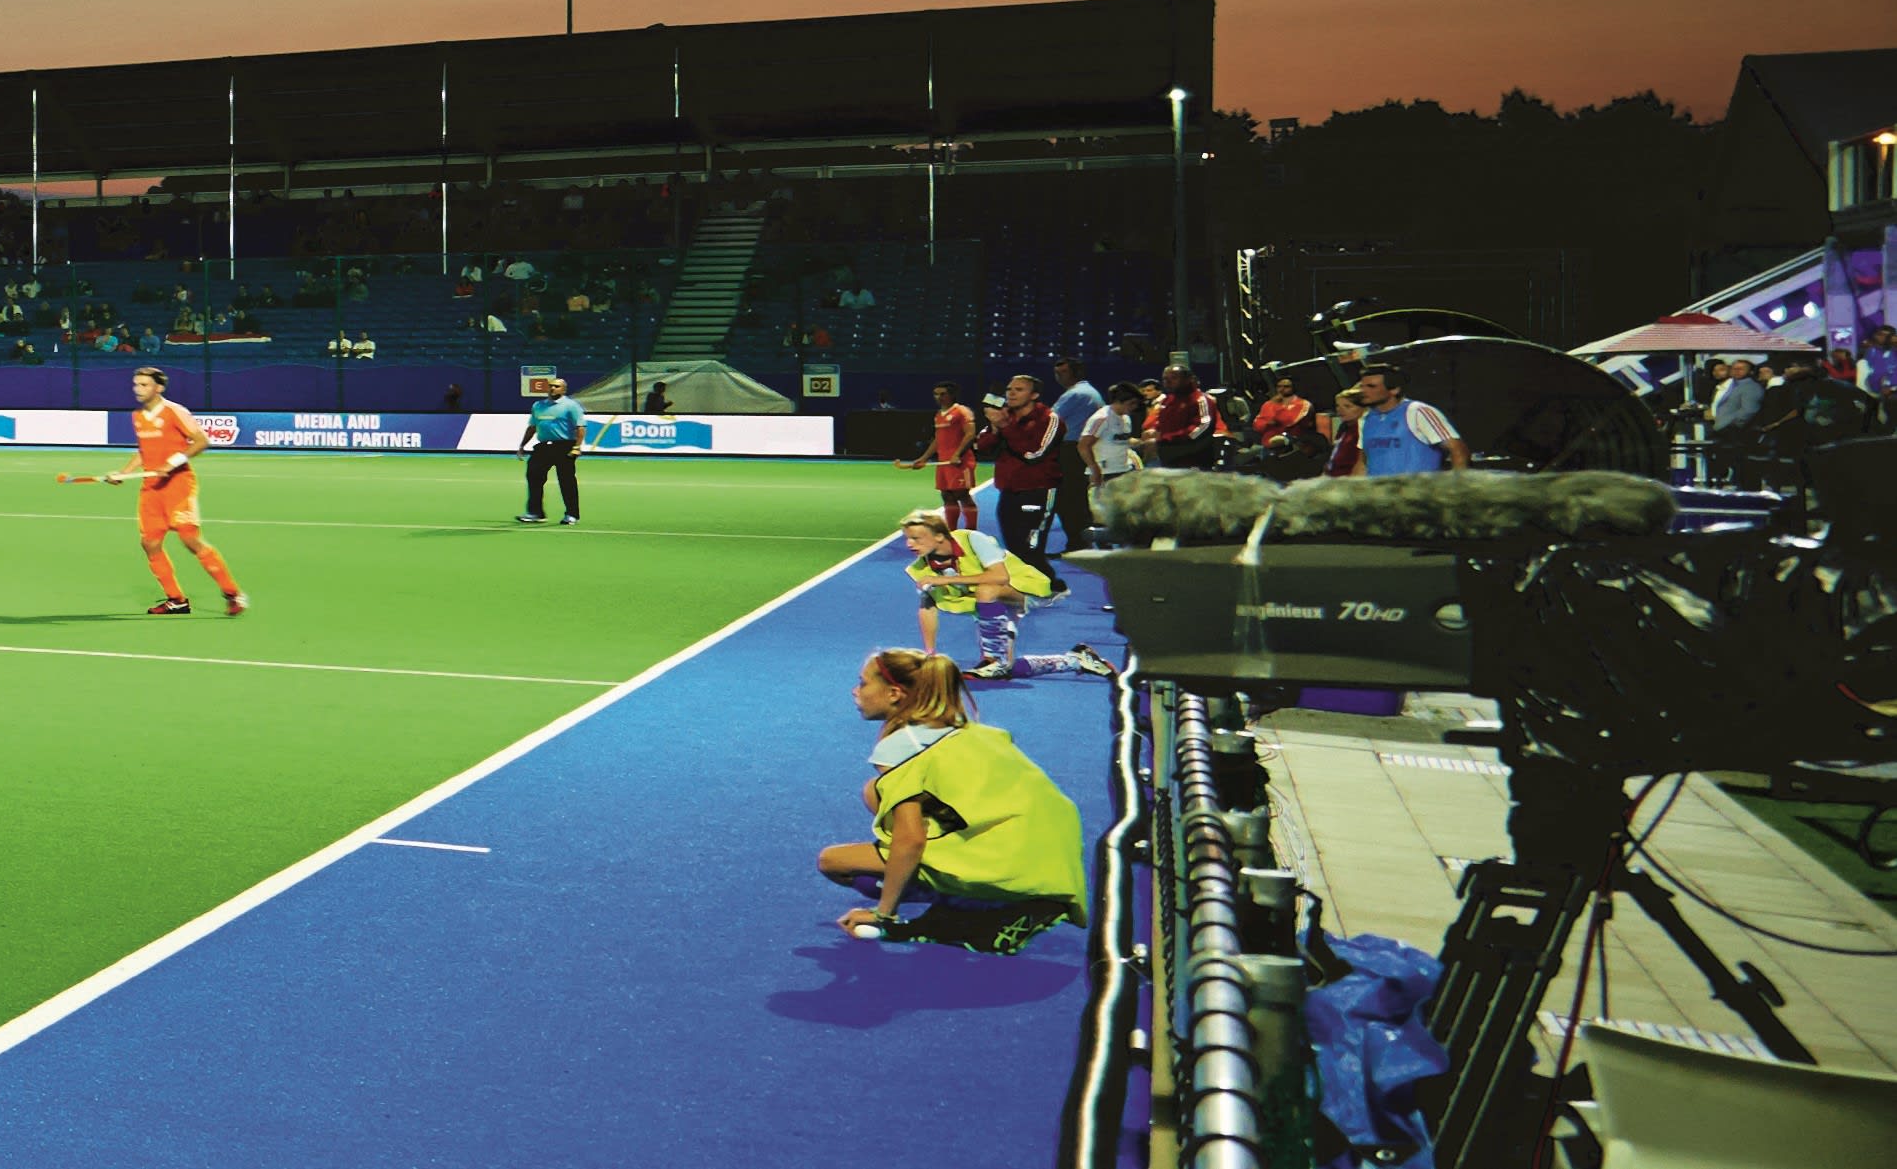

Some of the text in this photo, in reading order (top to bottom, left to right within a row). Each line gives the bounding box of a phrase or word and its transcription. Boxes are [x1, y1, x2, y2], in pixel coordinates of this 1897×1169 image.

[811, 380, 831, 390] D2
[294, 414, 380, 430] MEDIA AND
[621, 422, 677, 438] Boom
[255, 431, 422, 448] SUPPORTING PARTNER
